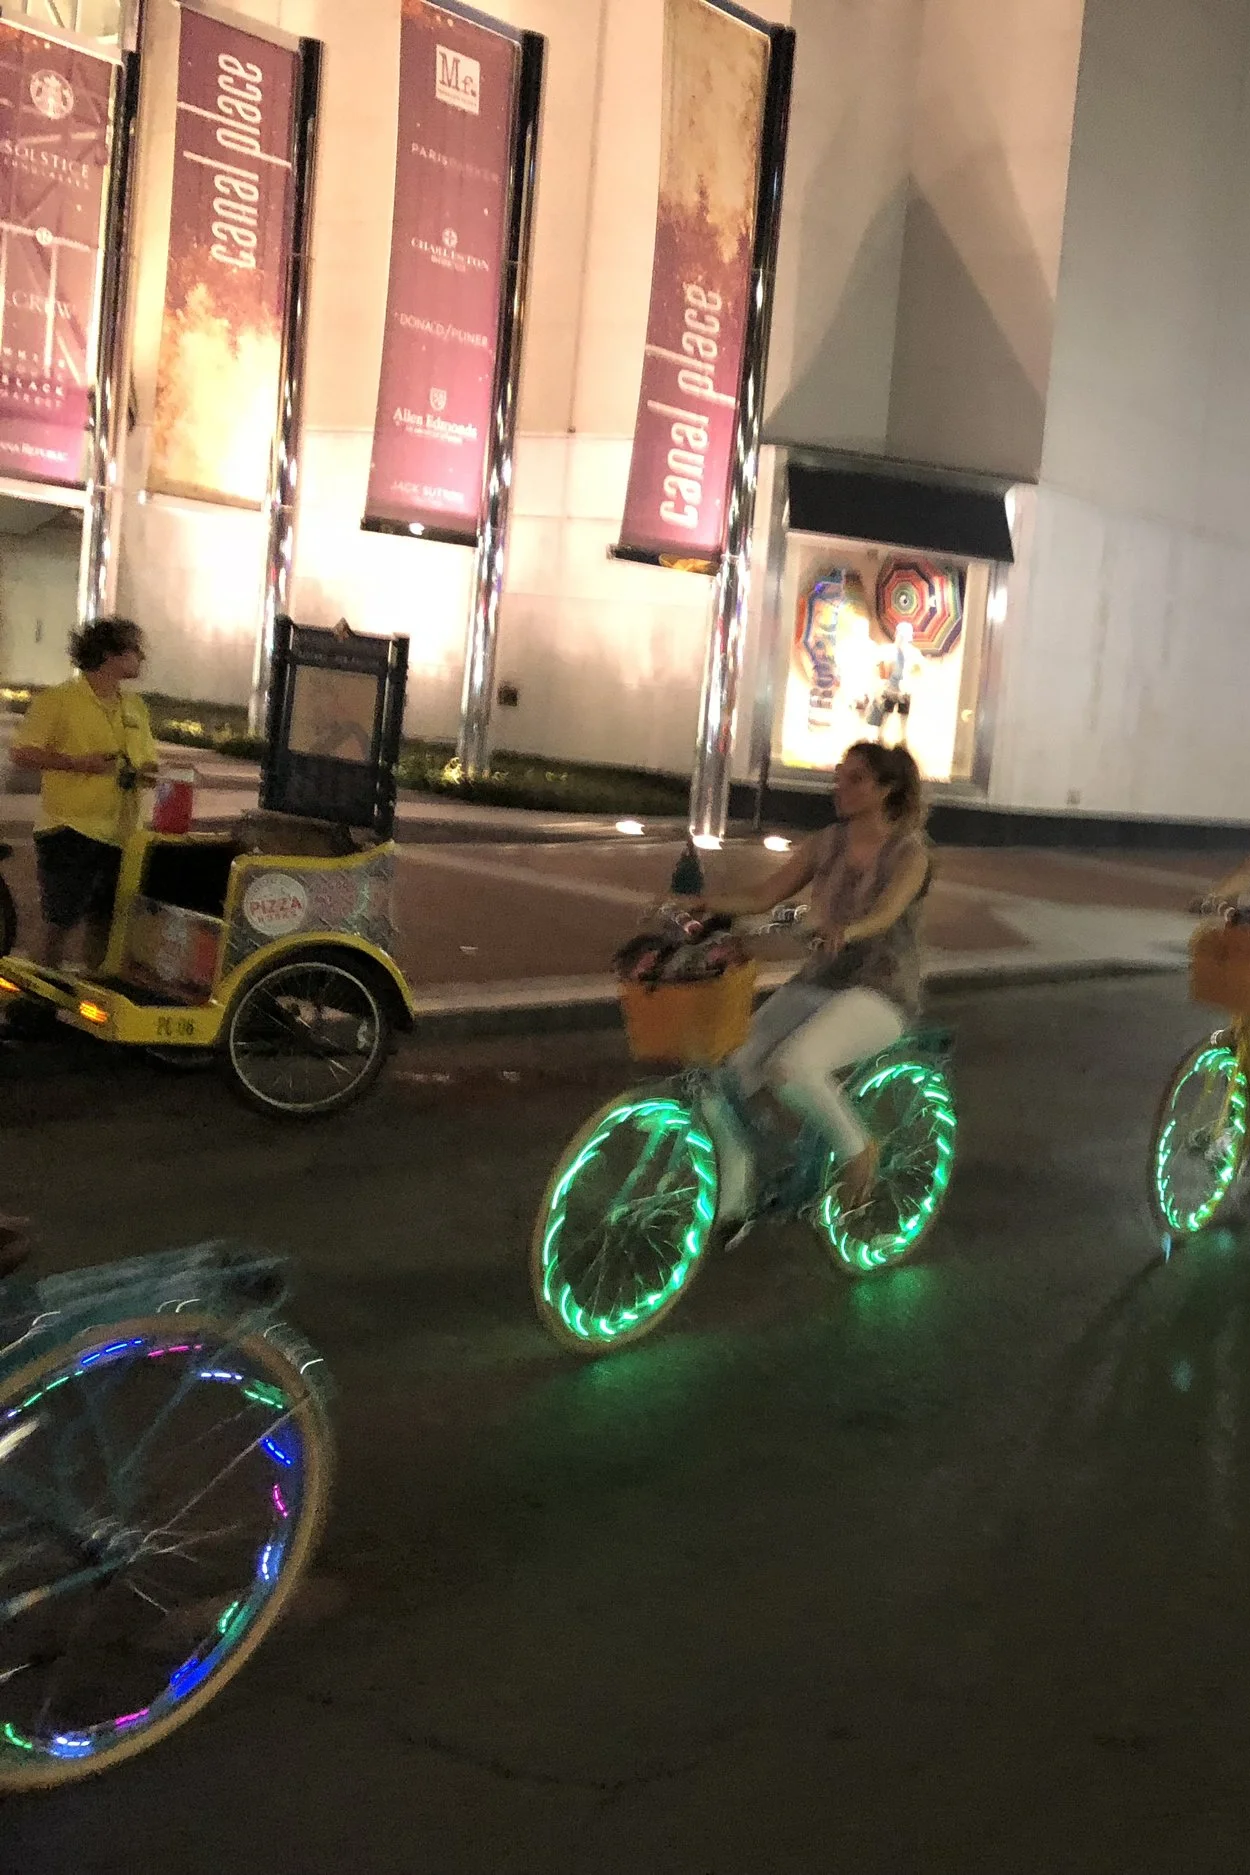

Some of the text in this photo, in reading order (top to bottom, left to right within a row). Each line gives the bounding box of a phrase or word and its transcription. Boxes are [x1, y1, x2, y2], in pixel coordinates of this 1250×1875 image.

[5, 140, 89, 179] SOLSTICE
[176, 53, 293, 270] canal place
[2, 373, 64, 397] BLACK
[392, 406, 424, 426] Allen
[426, 412, 477, 440] Edmonds
[645, 282, 737, 529] canal place
[250, 895, 302, 916] PIZZA
